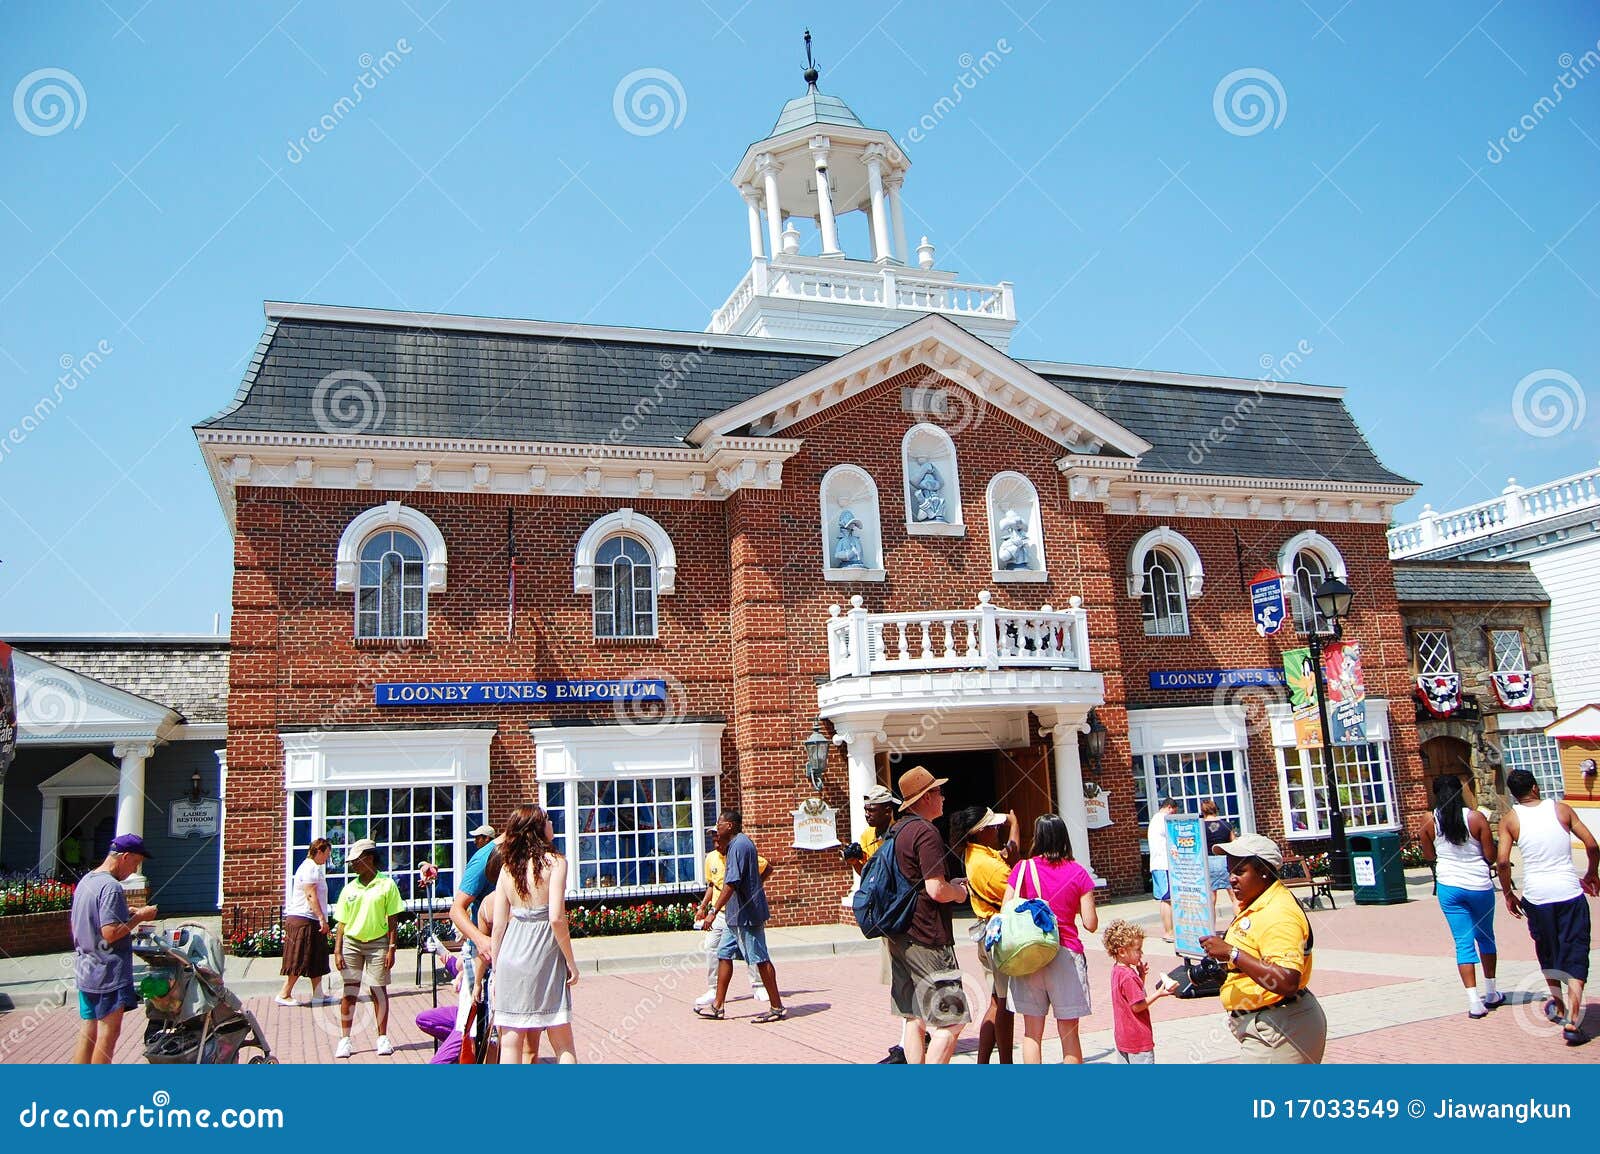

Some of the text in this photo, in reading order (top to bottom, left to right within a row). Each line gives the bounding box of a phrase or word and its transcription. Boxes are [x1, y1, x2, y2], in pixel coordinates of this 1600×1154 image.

[1160, 673, 1214, 686] LOONEY
[1219, 672, 1263, 684] TUNES
[388, 683, 657, 701] LOONEY TUNES EMPORIUM
